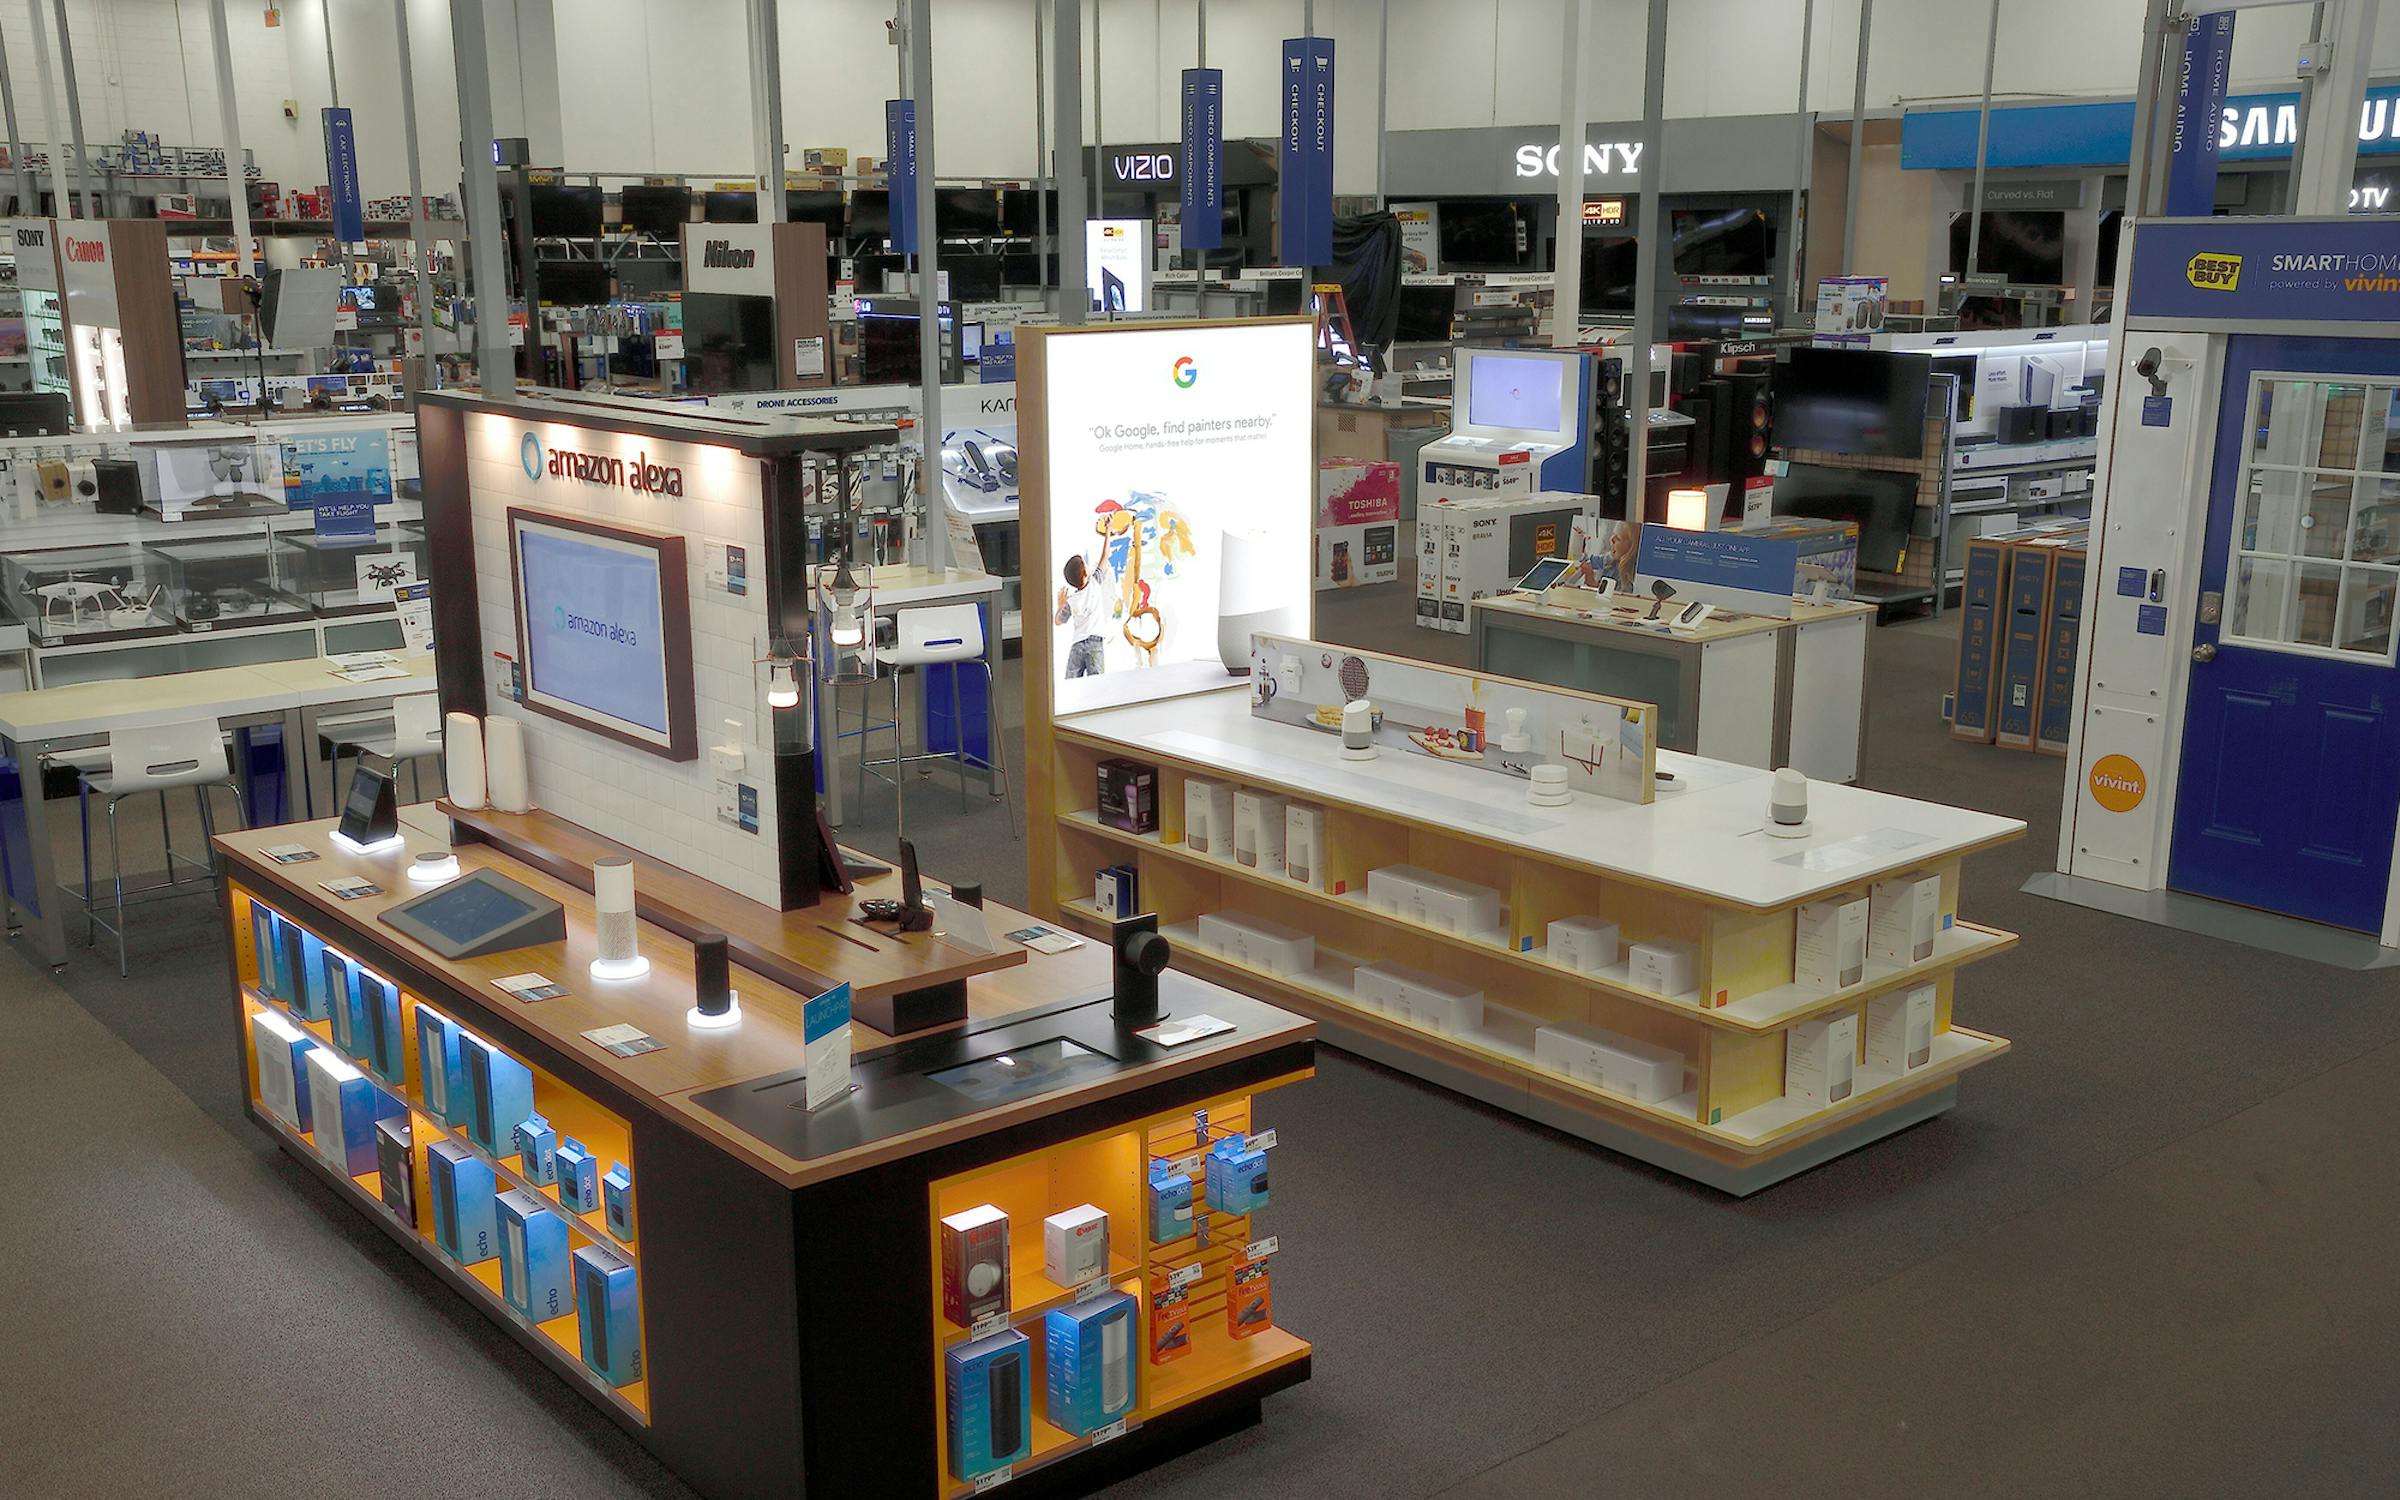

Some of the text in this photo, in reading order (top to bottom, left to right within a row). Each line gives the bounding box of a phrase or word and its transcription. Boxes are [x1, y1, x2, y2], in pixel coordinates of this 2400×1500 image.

[2173, 50, 2193, 153] HOME AUDIO
[2205, 49, 2224, 152] HOME AUDIO
[1207, 103, 1215, 136] VIDEO
[1290, 83, 1299, 153] CHECKOUT
[1316, 83, 1325, 152] CHECKOUT
[907, 130, 915, 158] SMALL
[339, 134, 353, 203] CAR ELECTRONICS
[1114, 154, 1174, 180] VIZIO
[1988, 189, 2054, 201] Curved vs. Flat
[17, 229, 44, 247] SONY
[65, 236, 105, 263] Canon
[704, 240, 755, 269] Nikon
[2272, 254, 2400, 271] SMARTHOM
[2193, 258, 2240, 285] BEST BUY
[2344, 272, 2400, 292] vivin
[2269, 278, 2338, 292] powered by
[1720, 341, 1755, 355] Klipsch
[757, 396, 838, 409] DRONE ACCESSORIES
[1115, 423, 1160, 440] Google,
[1163, 421, 1185, 435] find
[1188, 418, 1232, 436] painters
[332, 437, 357, 451] FLY
[1099, 443, 1123, 454] Google
[548, 449, 683, 497] amazon alexa
[1348, 497, 1388, 510] TOSHIBA
[1473, 518, 1497, 528] SONY
[1538, 527, 1553, 538] 4K
[1536, 541, 1554, 552] HDR
[568, 614, 637, 646] amazon alexa
[2094, 774, 2142, 795] vivint.
[479, 1230, 488, 1257] echo
[549, 1288, 558, 1315] echo
[633, 1350, 641, 1378] echo
[963, 1361, 984, 1374] echo
